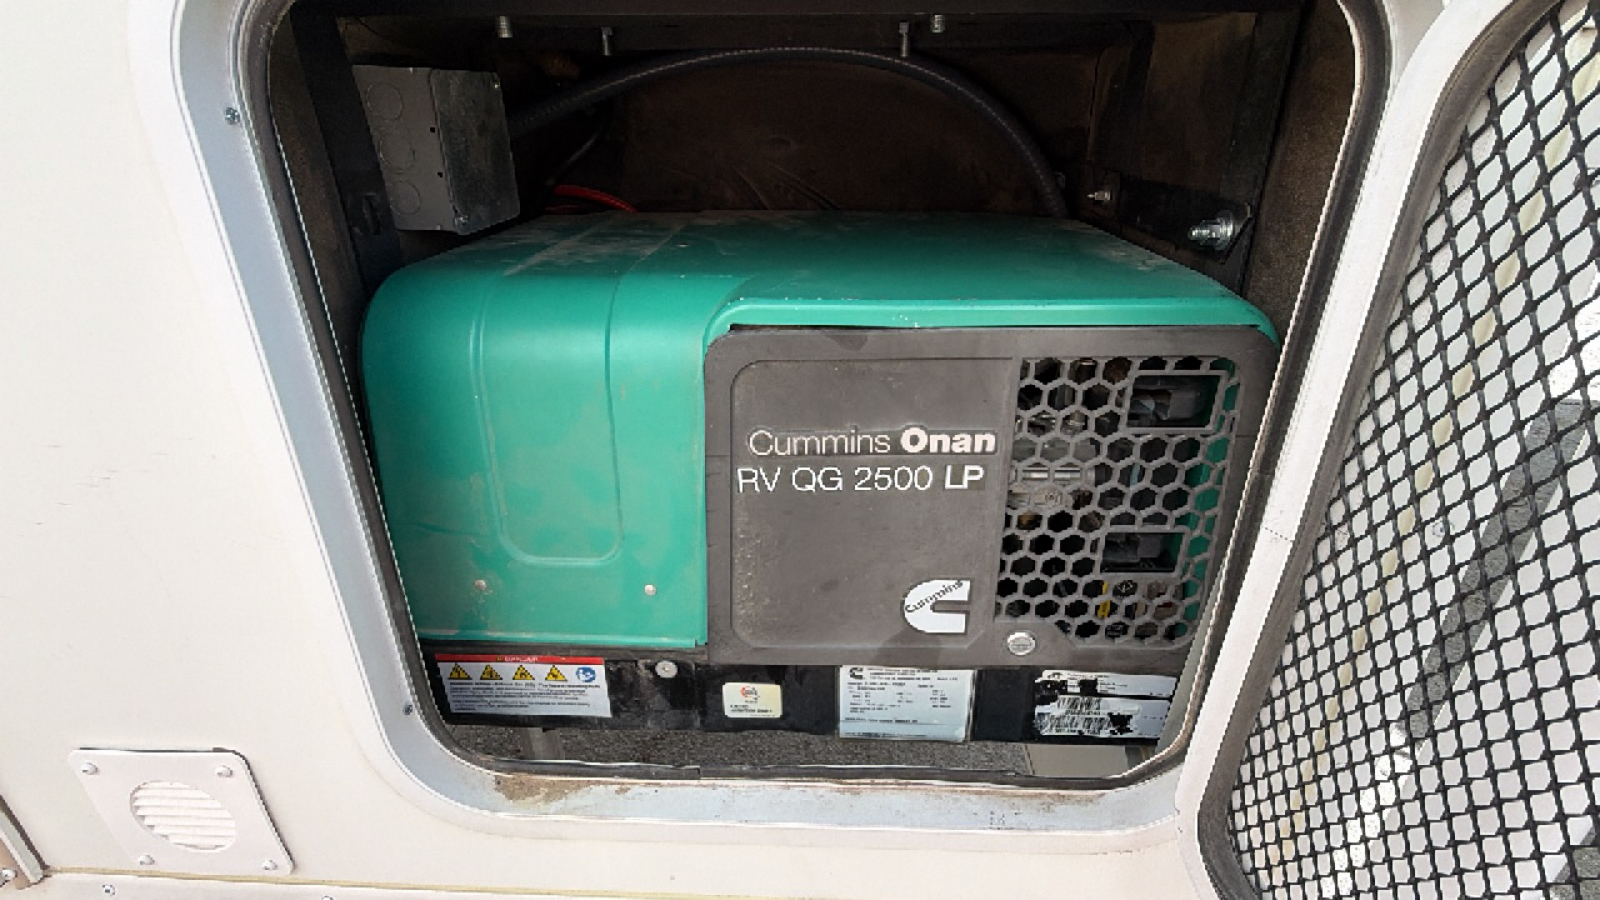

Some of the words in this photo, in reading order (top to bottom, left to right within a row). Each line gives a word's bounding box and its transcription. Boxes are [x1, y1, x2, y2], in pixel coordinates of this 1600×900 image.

[750, 430, 890, 455] Cummins
[900, 427, 996, 453] Onan
[737, 467, 781, 493] RV
[792, 467, 844, 493] QG
[855, 466, 933, 491] 2500
[944, 465, 984, 490] LP
[905, 580, 963, 613] Cummins
